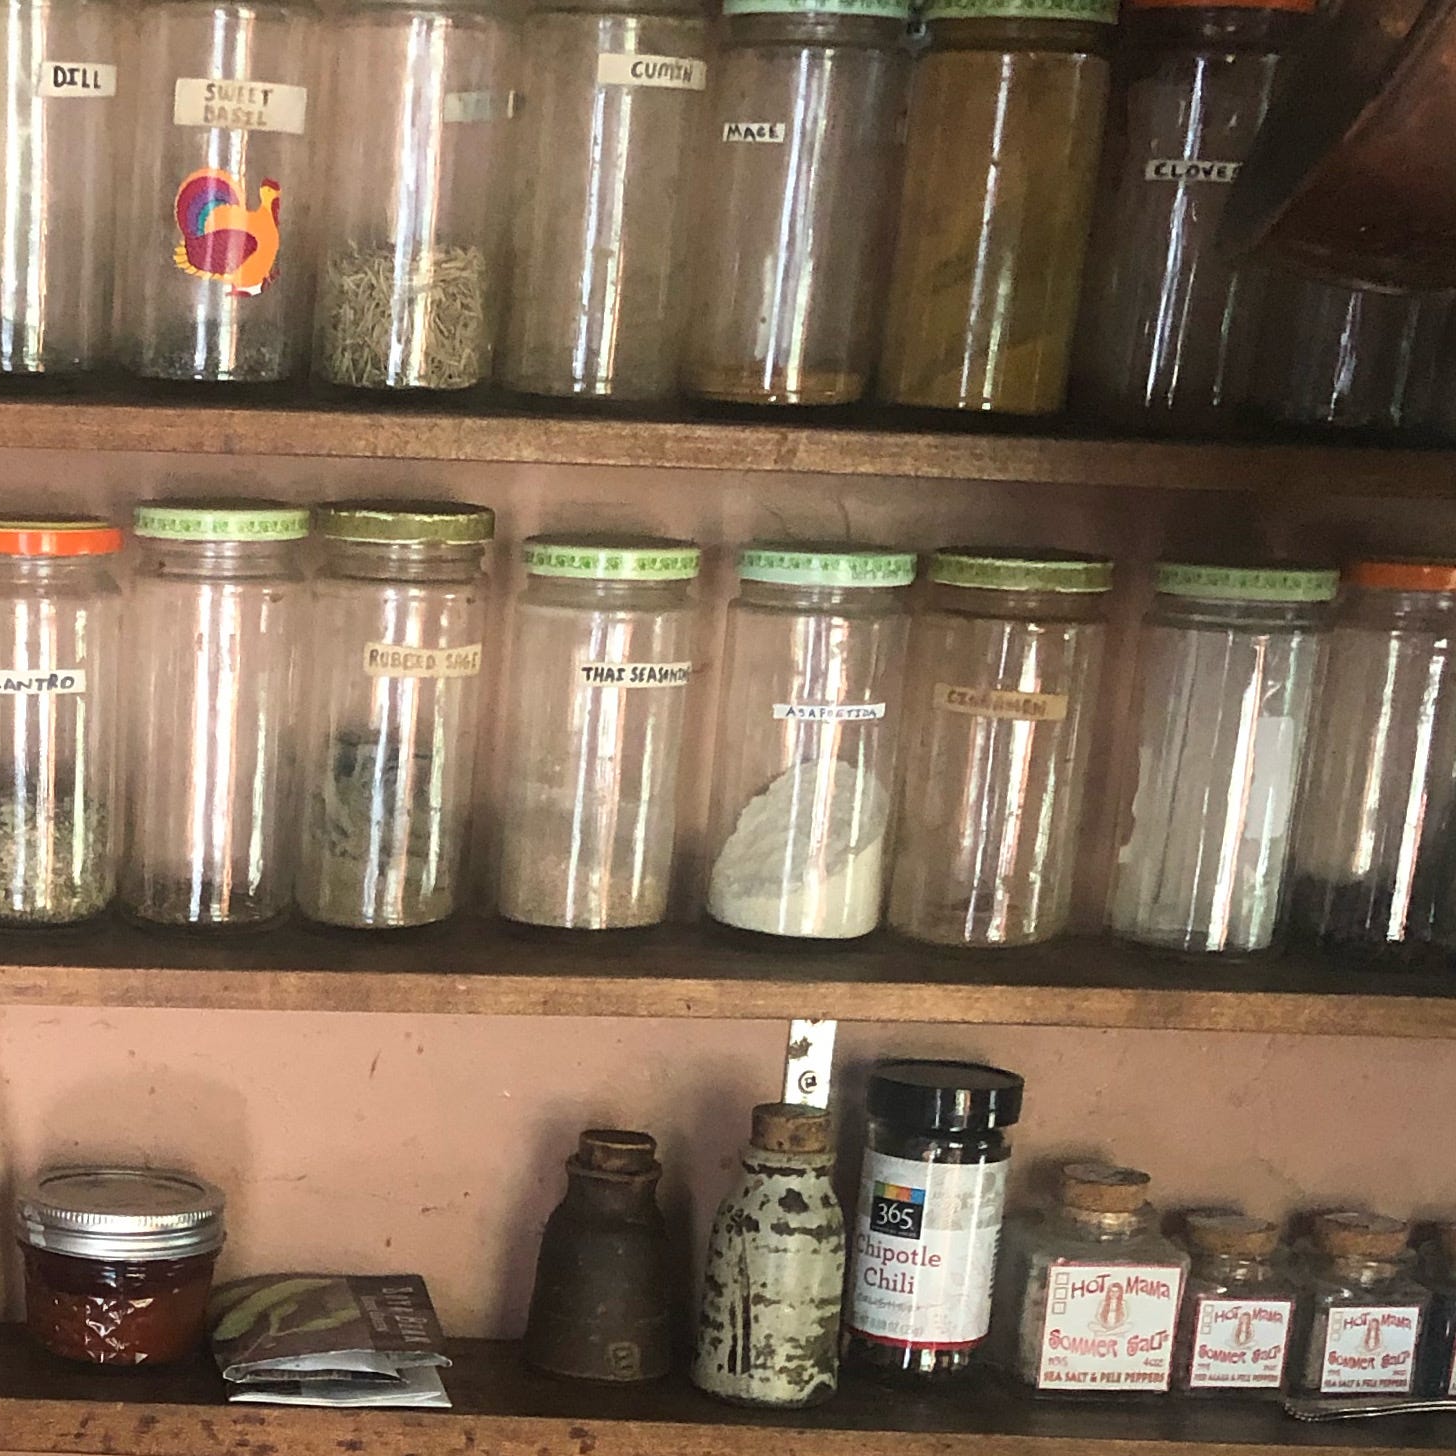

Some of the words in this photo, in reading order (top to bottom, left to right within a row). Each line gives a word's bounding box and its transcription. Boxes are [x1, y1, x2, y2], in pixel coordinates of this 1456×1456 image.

[53, 65, 102, 90] DILL
[630, 61, 694, 83] CUMIN
[205, 83, 274, 107] SWEET
[204, 105, 267, 126] BASIL
[727, 124, 779, 142] MACE
[581, 665, 626, 683] THAI
[876, 1203, 915, 1230] 365
[857, 1233, 942, 1268] Chipotle
[864, 1266, 915, 1295] Chili
[1071, 1274, 1111, 1299] HOT
